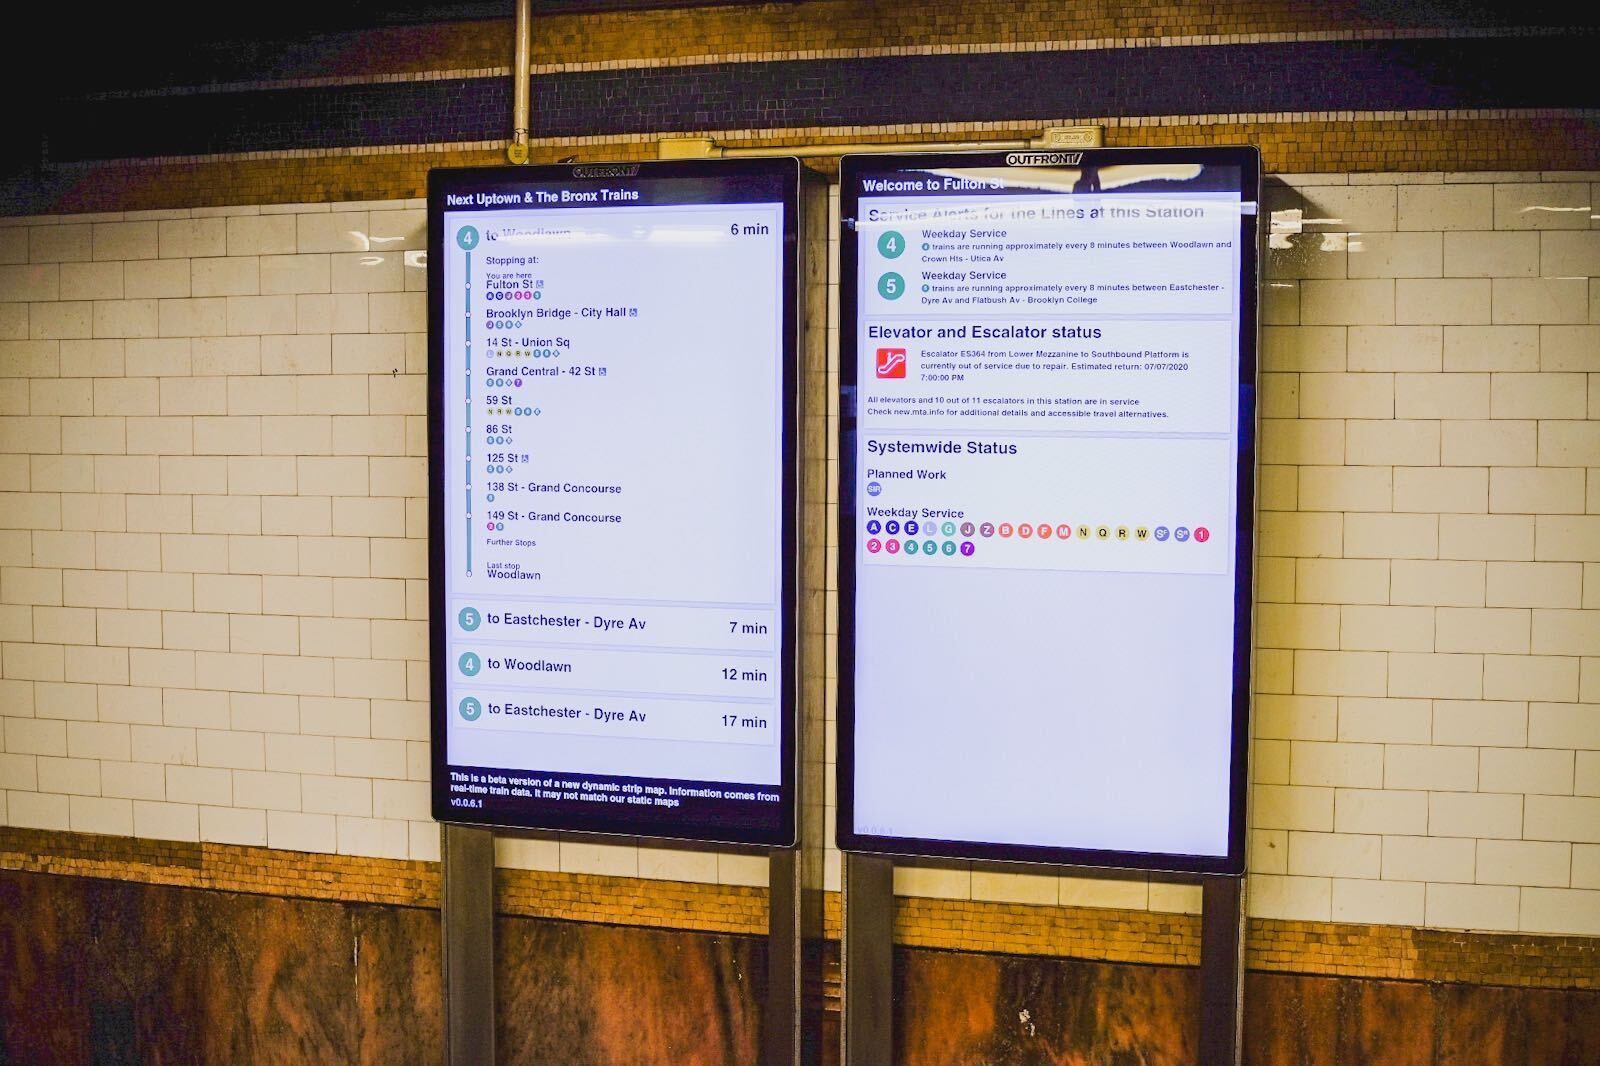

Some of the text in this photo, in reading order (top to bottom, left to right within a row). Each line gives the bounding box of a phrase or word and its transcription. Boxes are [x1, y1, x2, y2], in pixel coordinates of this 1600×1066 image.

[862, 179, 923, 191] Welcome
[925, 178, 940, 191] to
[943, 176, 986, 190] Fulton
[446, 188, 639, 207] Next Uptown & The Bronx Trains
[730, 222, 739, 235] 6
[742, 222, 768, 235] min
[921, 228, 1007, 240] Weekday Service
[971, 242, 1003, 251] running
[1004, 241, 1063, 251] approximately
[1064, 242, 1087, 250] every
[1168, 240, 1213, 248] Woodlawn
[485, 255, 538, 266] Stopping at:
[921, 270, 1006, 282] Weekday Service
[485, 278, 533, 289] Fulton St
[931, 284, 954, 292] trains
[971, 284, 1003, 293] running
[1004, 283, 1062, 293] approximately
[1064, 285, 1087, 293] every
[1096, 283, 1130, 291] minutes
[1131, 283, 1167, 291] between
[1169, 283, 1219, 291] Eastchester
[485, 306, 626, 320] Brooklyn Bridge City Hall
[868, 324, 1101, 338] Elevator and Escalator status
[486, 337, 569, 349] 14 St Union Sq
[485, 365, 595, 376] Grand Central 42 St
[485, 394, 512, 405] 59 St
[485, 423, 512, 433] 86 St
[867, 439, 1017, 456] Systemwide Status
[486, 452, 518, 463] 125 St
[867, 468, 946, 479] Planned Work
[486, 481, 621, 493] 138 St Grand Concourse
[867, 485, 881, 493] SIR
[486, 510, 621, 523] 149 St Grand Concourse
[866, 506, 964, 520] Weekday Service
[485, 537, 536, 547] Further Stops
[486, 561, 520, 571] Last stop
[486, 568, 540, 580] Woodlawn
[486, 612, 767, 634] to Eastchester Dyre Av 7 min
[487, 657, 767, 681] to Woodlawn 12 min
[487, 702, 767, 728] to Eastchester Dyre Av 17 min
[449, 771, 780, 802] This beta version dynamic strip map. Information comes from
[449, 783, 679, 808] real-time train data. match our static maps
[450, 798, 482, 808] v0.0.6.1
